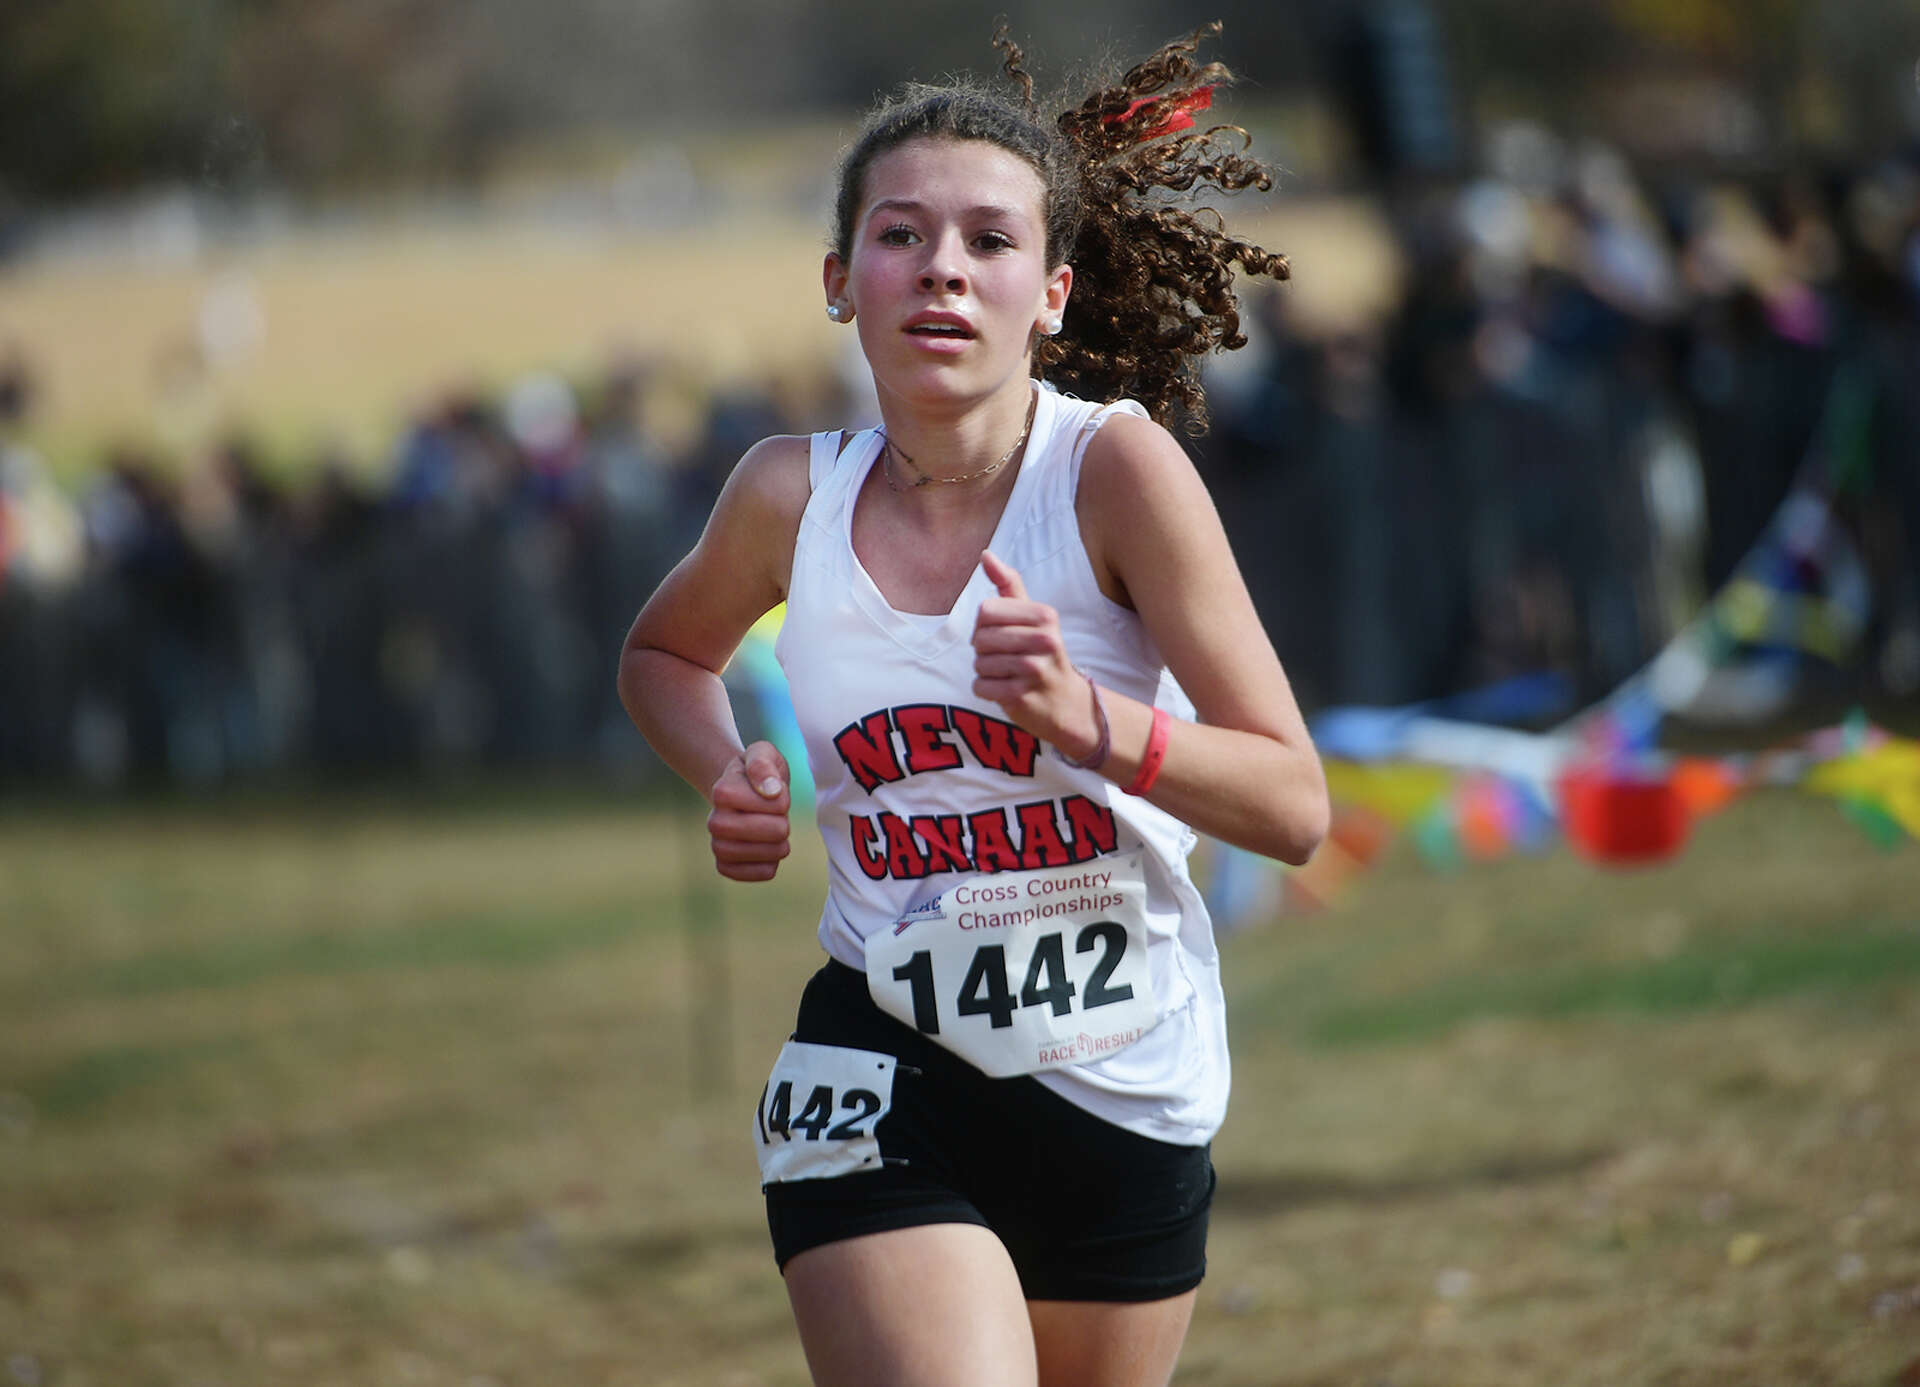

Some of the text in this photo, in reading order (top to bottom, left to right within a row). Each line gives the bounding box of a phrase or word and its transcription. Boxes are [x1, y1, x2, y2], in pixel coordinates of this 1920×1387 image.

[833, 703, 1042, 796] NEW
[850, 794, 1118, 880] CANAAN
[955, 871, 1111, 905] Cross Country
[958, 892, 1123, 931] Championships
[892, 921, 1134, 1035] 1442
[1039, 1045, 1075, 1063] RACE
[1095, 1028, 1142, 1051] RESULT
